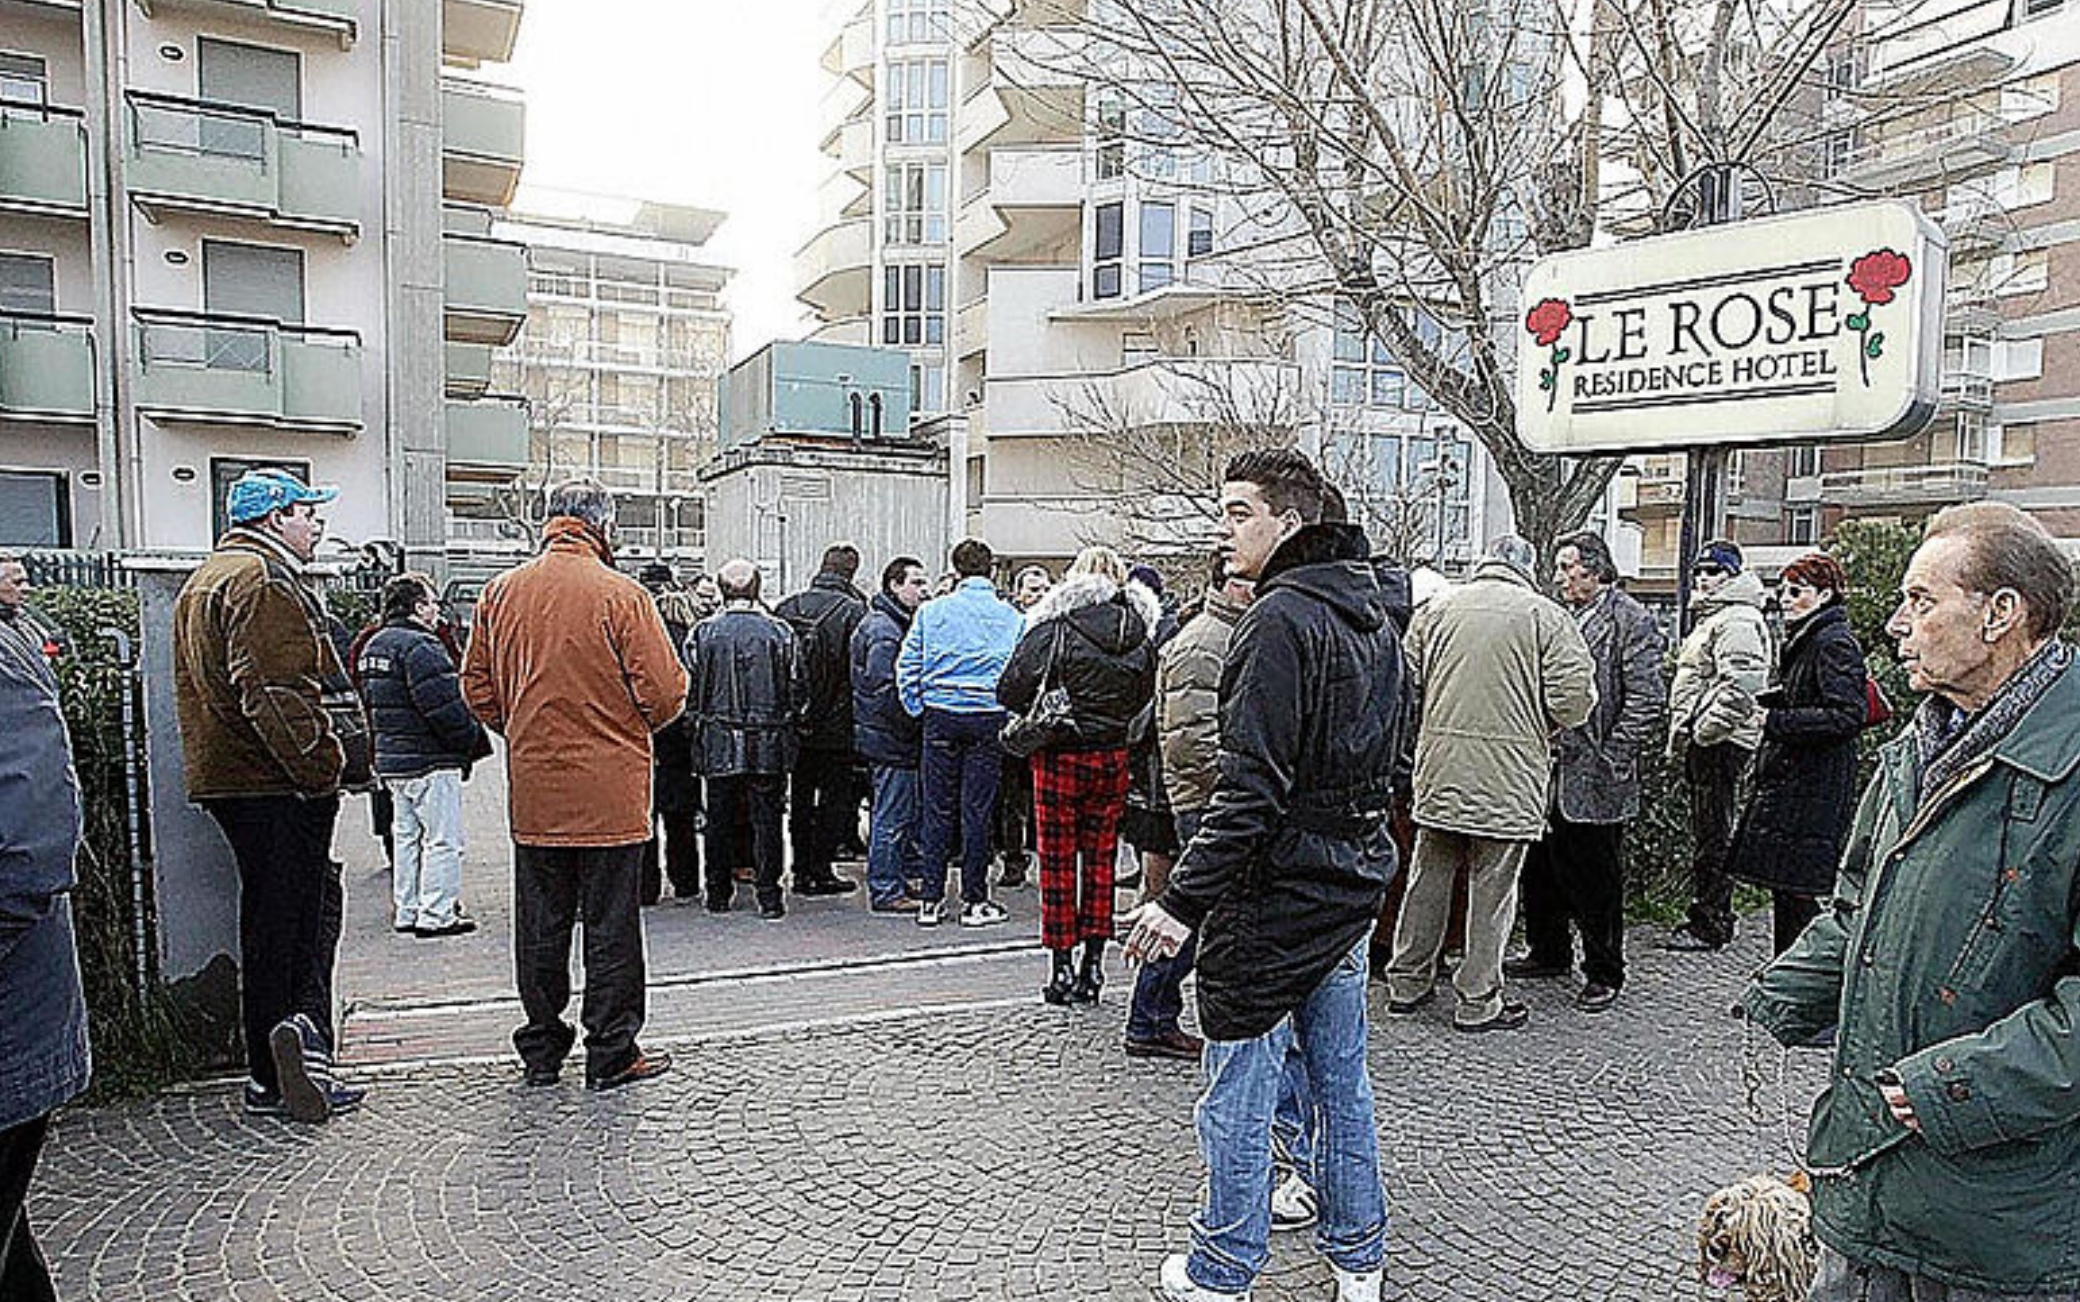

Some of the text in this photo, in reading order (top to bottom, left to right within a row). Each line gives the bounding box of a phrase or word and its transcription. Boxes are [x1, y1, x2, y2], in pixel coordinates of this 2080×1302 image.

[1575, 282, 1841, 366] LE ROSE
[1574, 349, 1837, 398] RESIDENCE HOTEL
